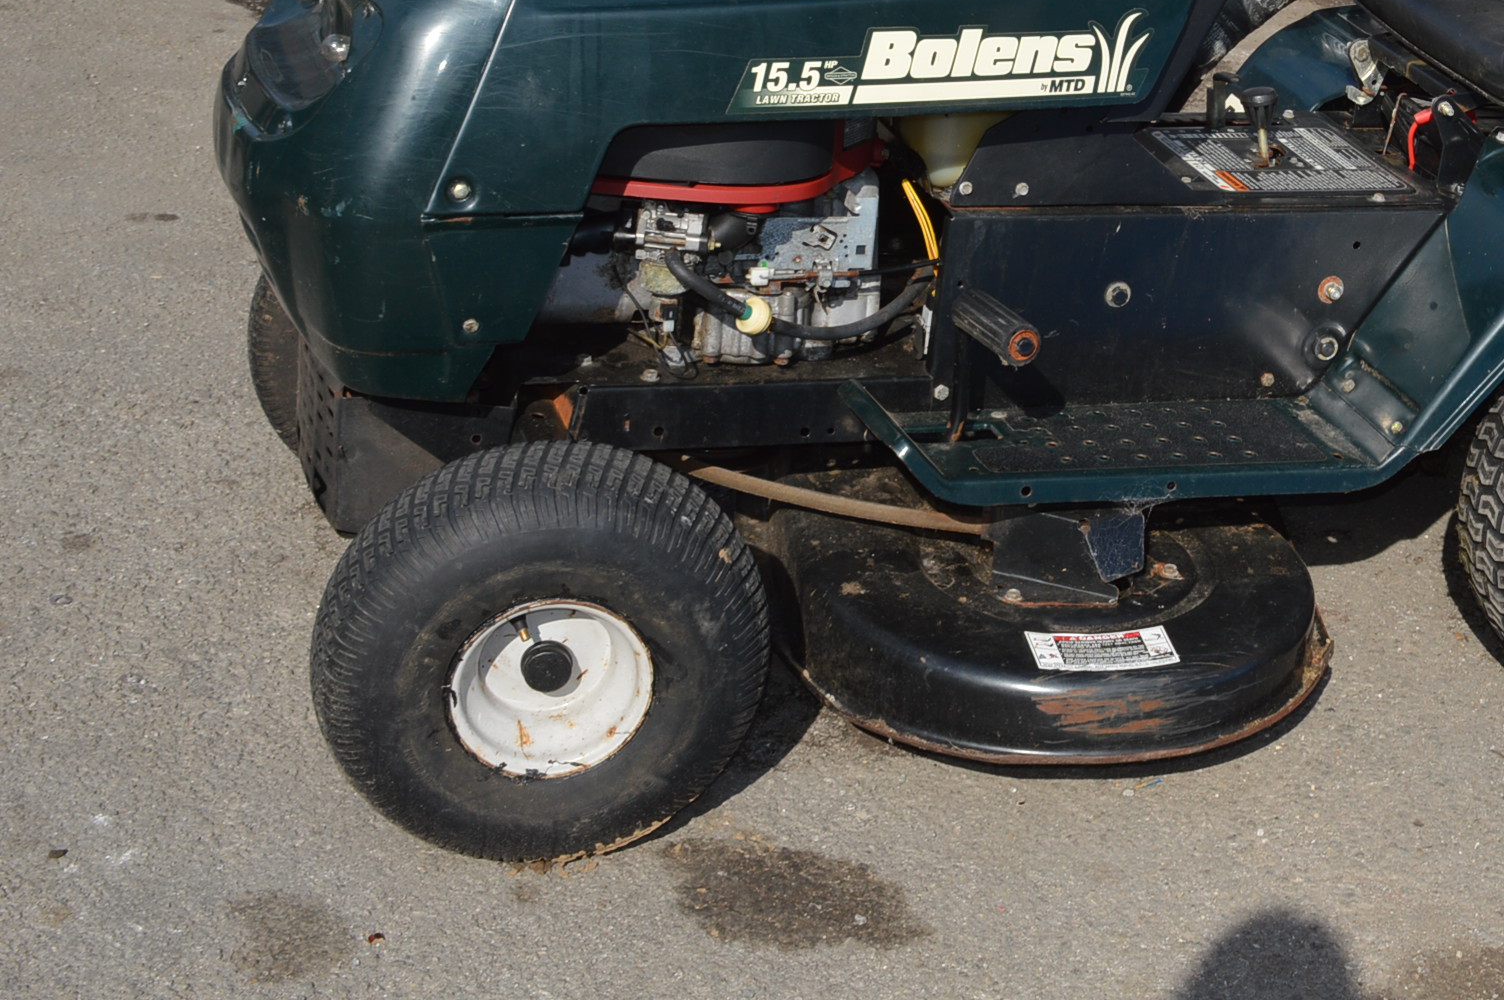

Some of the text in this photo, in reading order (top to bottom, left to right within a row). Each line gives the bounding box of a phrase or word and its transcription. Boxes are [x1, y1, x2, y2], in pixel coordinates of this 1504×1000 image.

[861, 28, 1096, 80] Bolens
[751, 60, 838, 92] 15.5 HP
[1040, 79, 1086, 93] by MTD
[756, 92, 840, 105] LAWN TRACTOR
